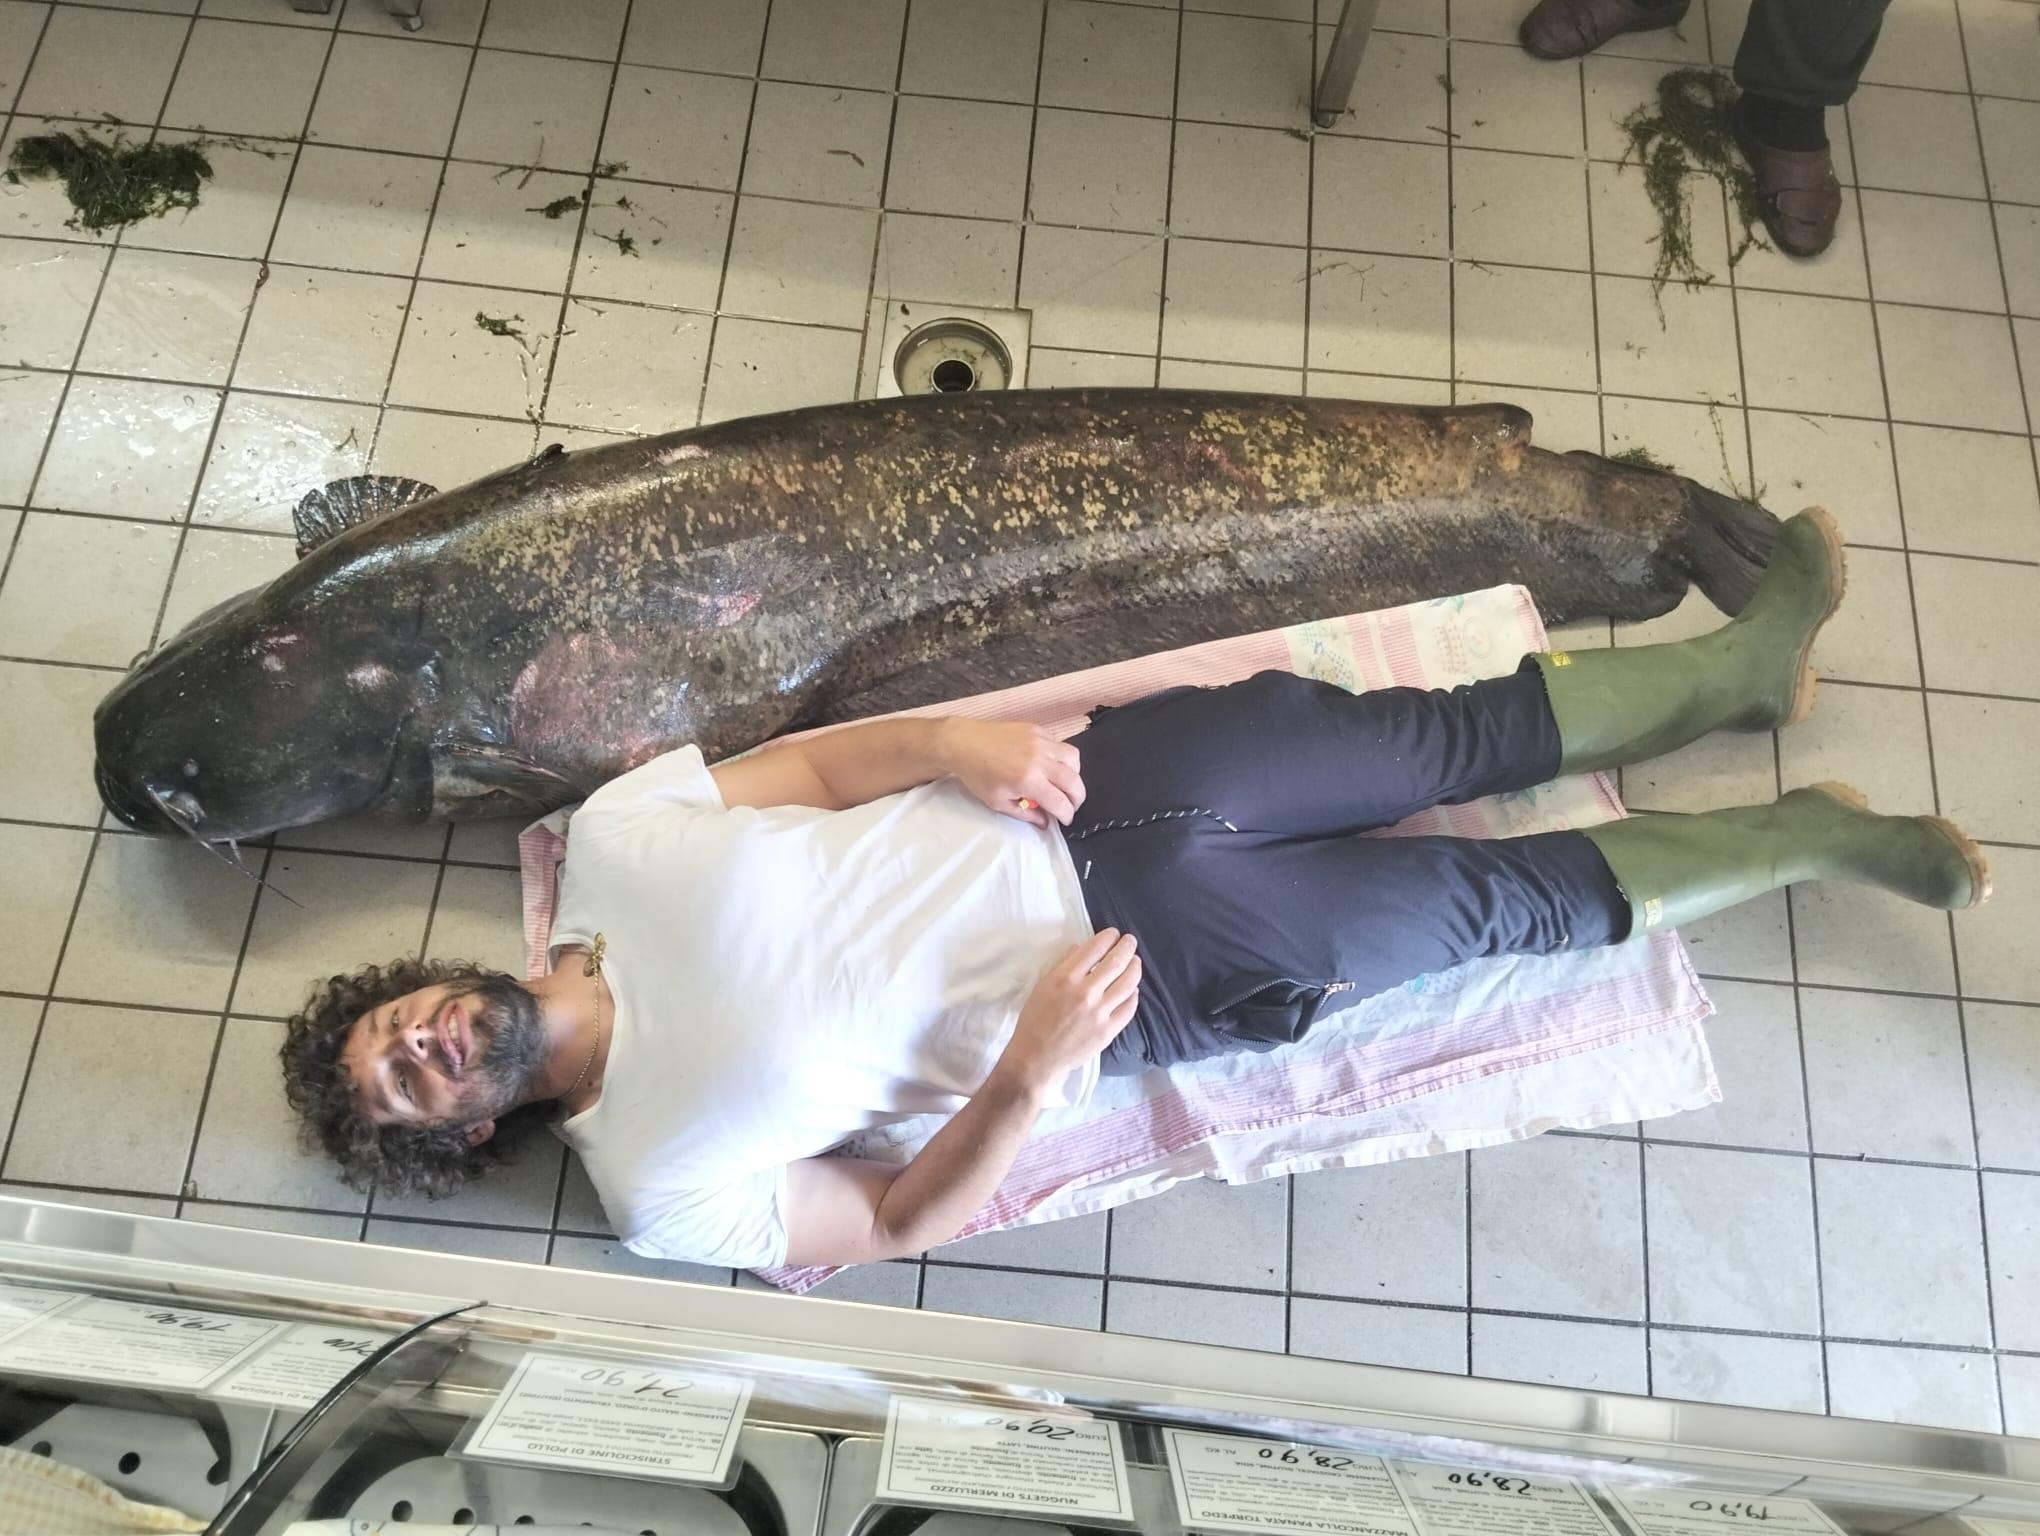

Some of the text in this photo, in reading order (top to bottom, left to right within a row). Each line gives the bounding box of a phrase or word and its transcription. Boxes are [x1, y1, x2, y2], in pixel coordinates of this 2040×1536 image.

[144, 1312, 232, 1332] 19,90
[229, 1385, 283, 1396] VERDURA
[580, 1368, 695, 1399] 21,90
[984, 1418, 1076, 1441] 20,90
[1074, 1431, 1106, 1441] EURO
[526, 1442, 672, 1465] STRISCIOLINE DI POLLO
[1257, 1448, 1355, 1471] 28,90
[1352, 1462, 1383, 1472] EURO
[1447, 1471, 1532, 1495] 28,90
[930, 1482, 1077, 1506] NUGGETS DI MERLUZZO
[1201, 1509, 1259, 1523] TORPEDO
[1689, 1500, 1777, 1521] 19,90
[1263, 1515, 1311, 1528] PANATA
[1316, 1520, 1407, 1536] MAZZANCOLLA
